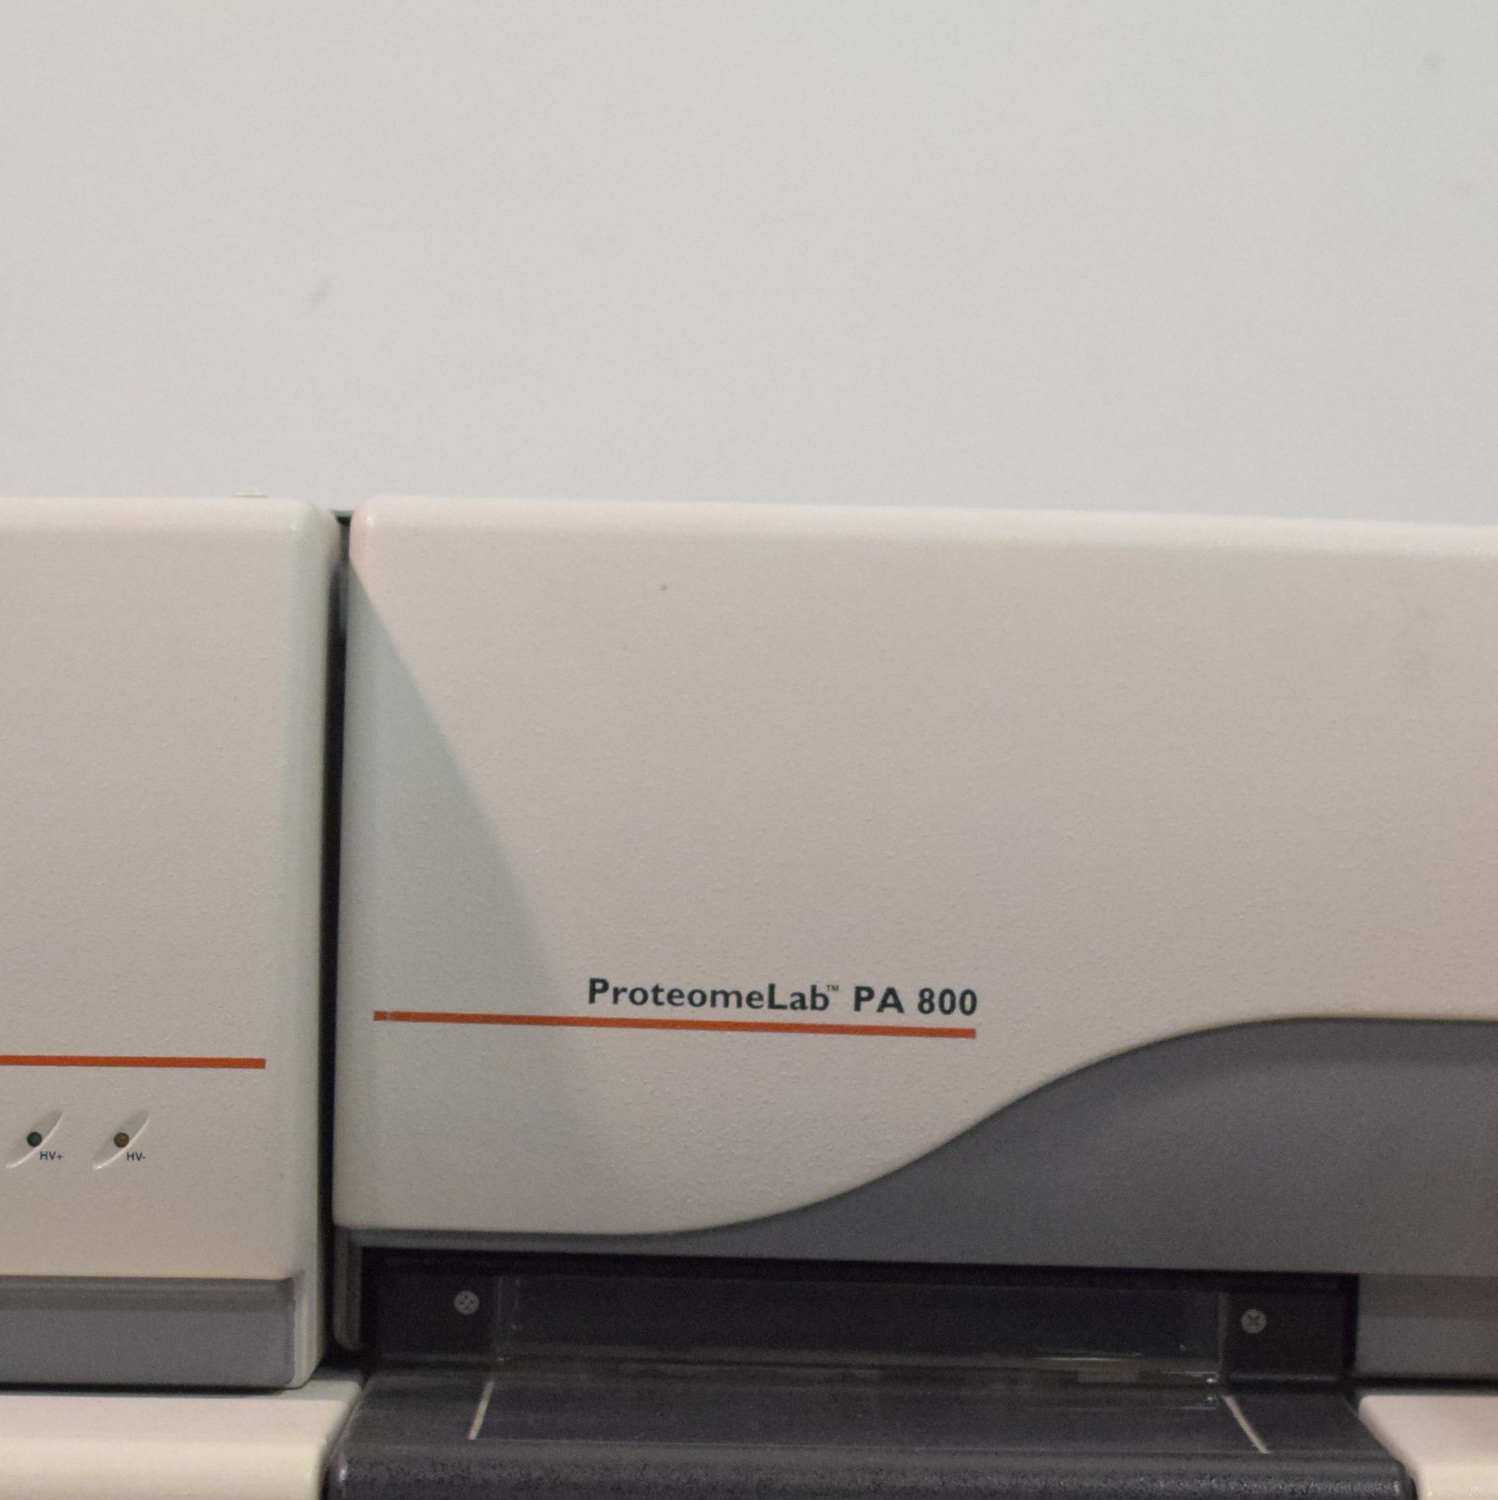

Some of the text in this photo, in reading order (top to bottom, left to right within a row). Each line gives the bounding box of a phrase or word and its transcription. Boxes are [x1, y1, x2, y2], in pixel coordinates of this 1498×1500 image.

[853, 985, 905, 1014] PA
[917, 988, 978, 1016] 800
[39, 1151, 63, 1161] HV+
